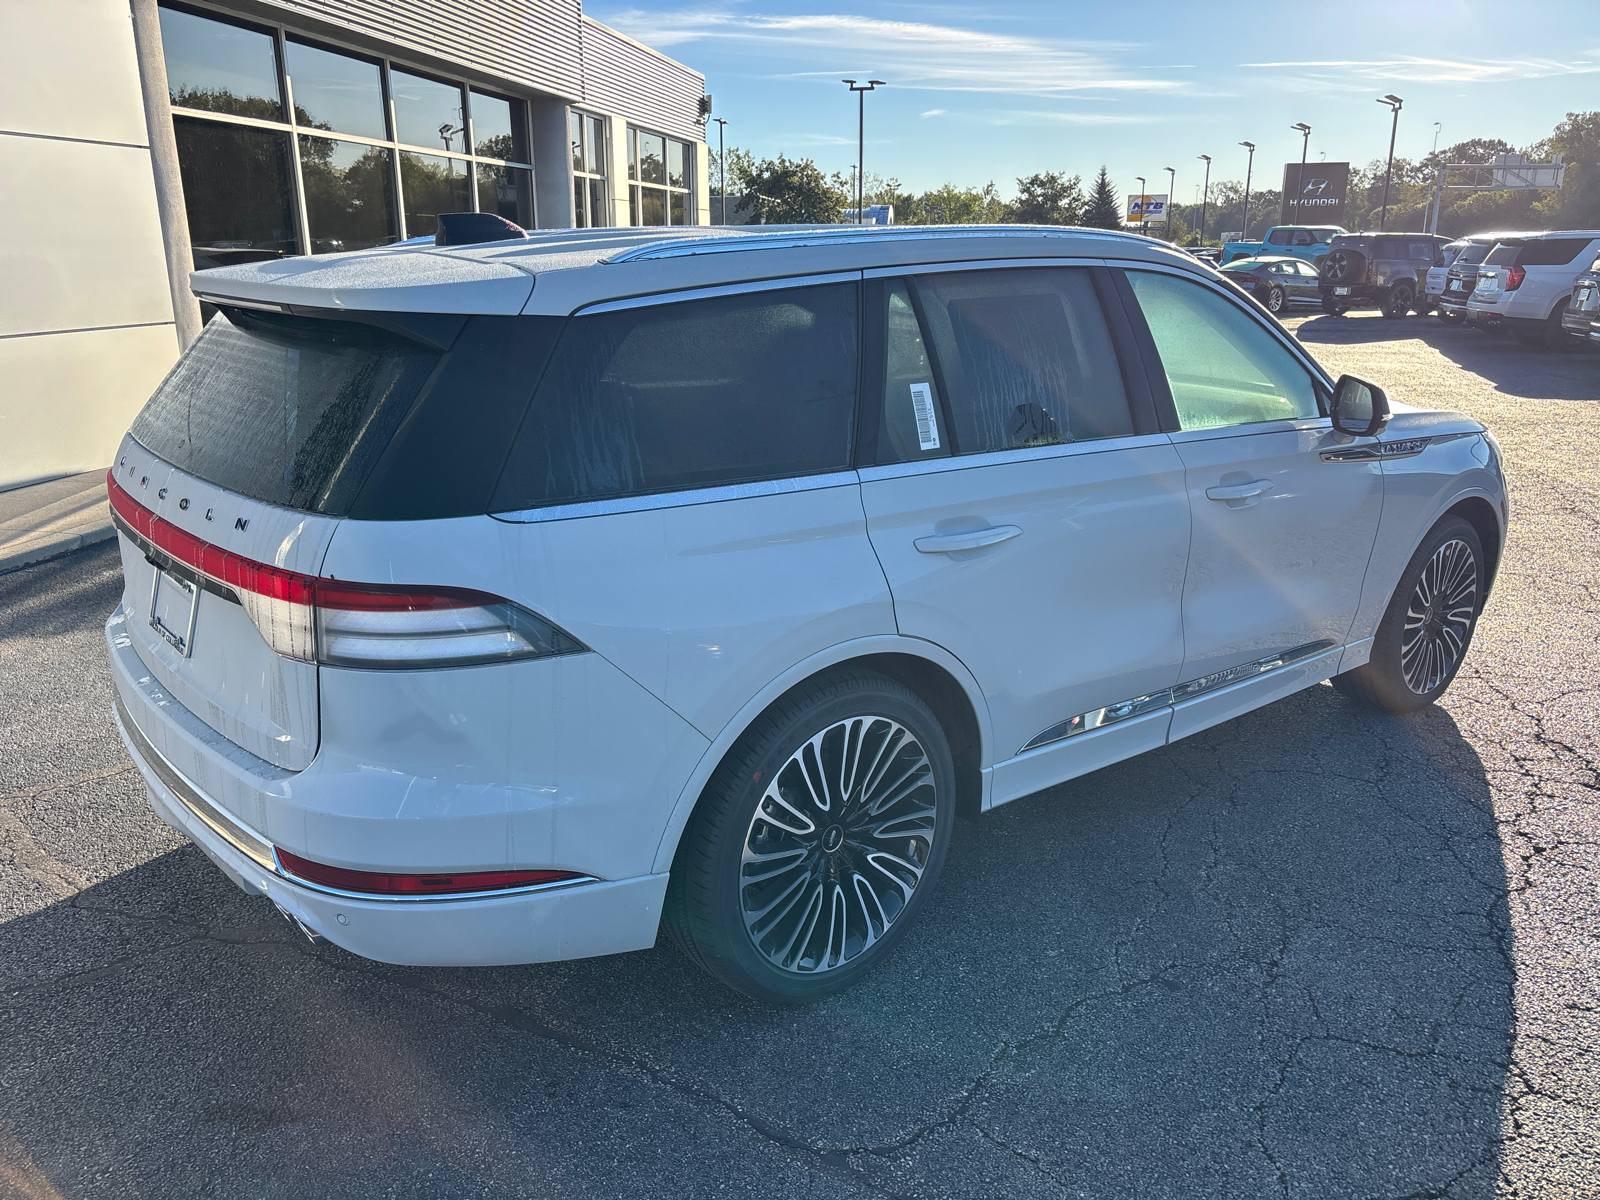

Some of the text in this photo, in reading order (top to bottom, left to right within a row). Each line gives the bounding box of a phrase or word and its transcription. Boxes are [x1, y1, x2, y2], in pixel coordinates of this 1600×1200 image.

[1132, 202, 1164, 210] NTB
[1289, 198, 1339, 207] HYUNDAI
[120, 455, 249, 532] LINCOLN
